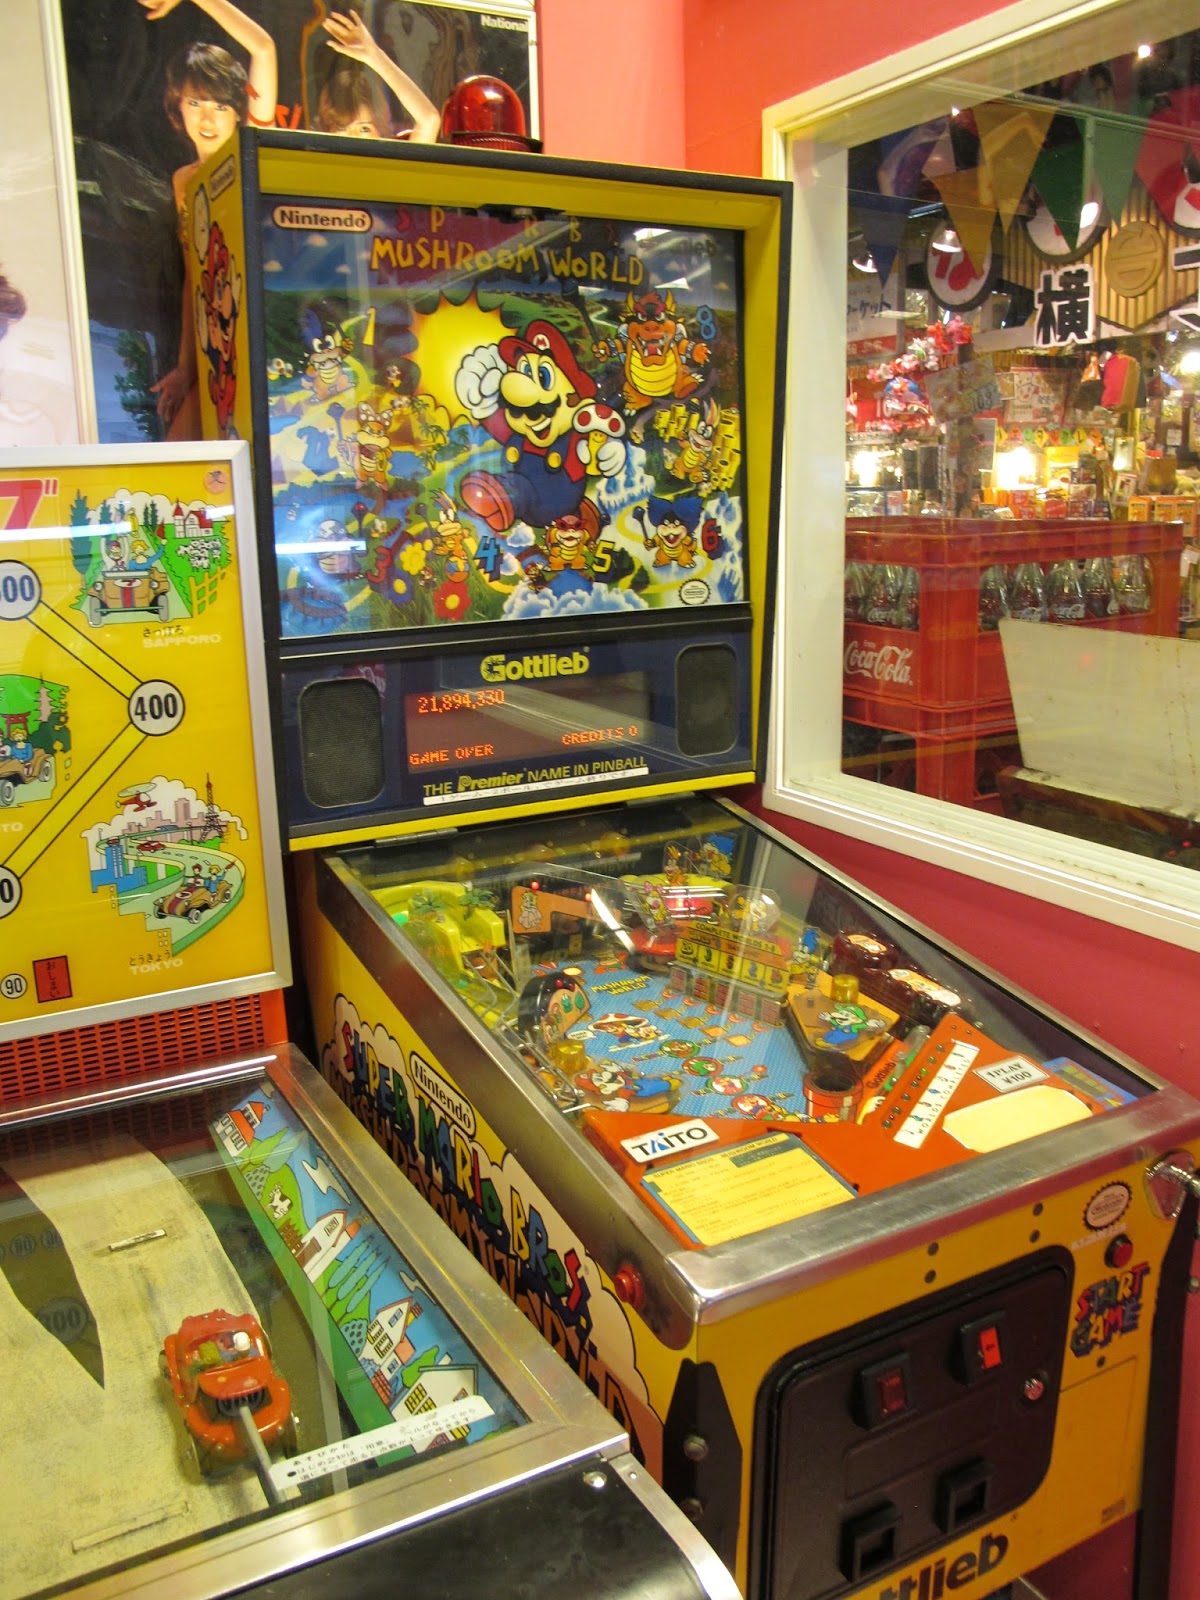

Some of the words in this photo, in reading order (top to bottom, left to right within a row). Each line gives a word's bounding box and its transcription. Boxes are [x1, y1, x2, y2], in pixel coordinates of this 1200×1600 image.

[481, 14, 528, 32] National
[278, 209, 366, 229] Nintendo
[371, 235, 540, 274] MUSHROOM
[547, 246, 644, 286] WORLD
[0, 573, 35, 602] 00
[143, 634, 222, 648] SAPPORO
[480, 650, 590, 683] Gottlieb
[134, 692, 178, 722] 400
[562, 727, 624, 746] CREDITS
[409, 750, 450, 766] GAME
[454, 743, 495, 761] OVER
[423, 782, 453, 796] THE
[457, 771, 524, 793] Premier
[527, 765, 571, 782] NAME
[573, 763, 590, 777] IN
[591, 756, 648, 773] PINBALL
[130, 959, 184, 975] TOKYO
[5, 979, 24, 995] 90
[866, 1059, 896, 1089] Gottlieb
[1002, 1070, 1032, 1085] ¥100
[414, 1064, 472, 1130] Nintendo
[631, 1127, 708, 1156] TAITO
[1075, 1262, 1149, 1321] START
[1071, 1300, 1141, 1358] GAME
